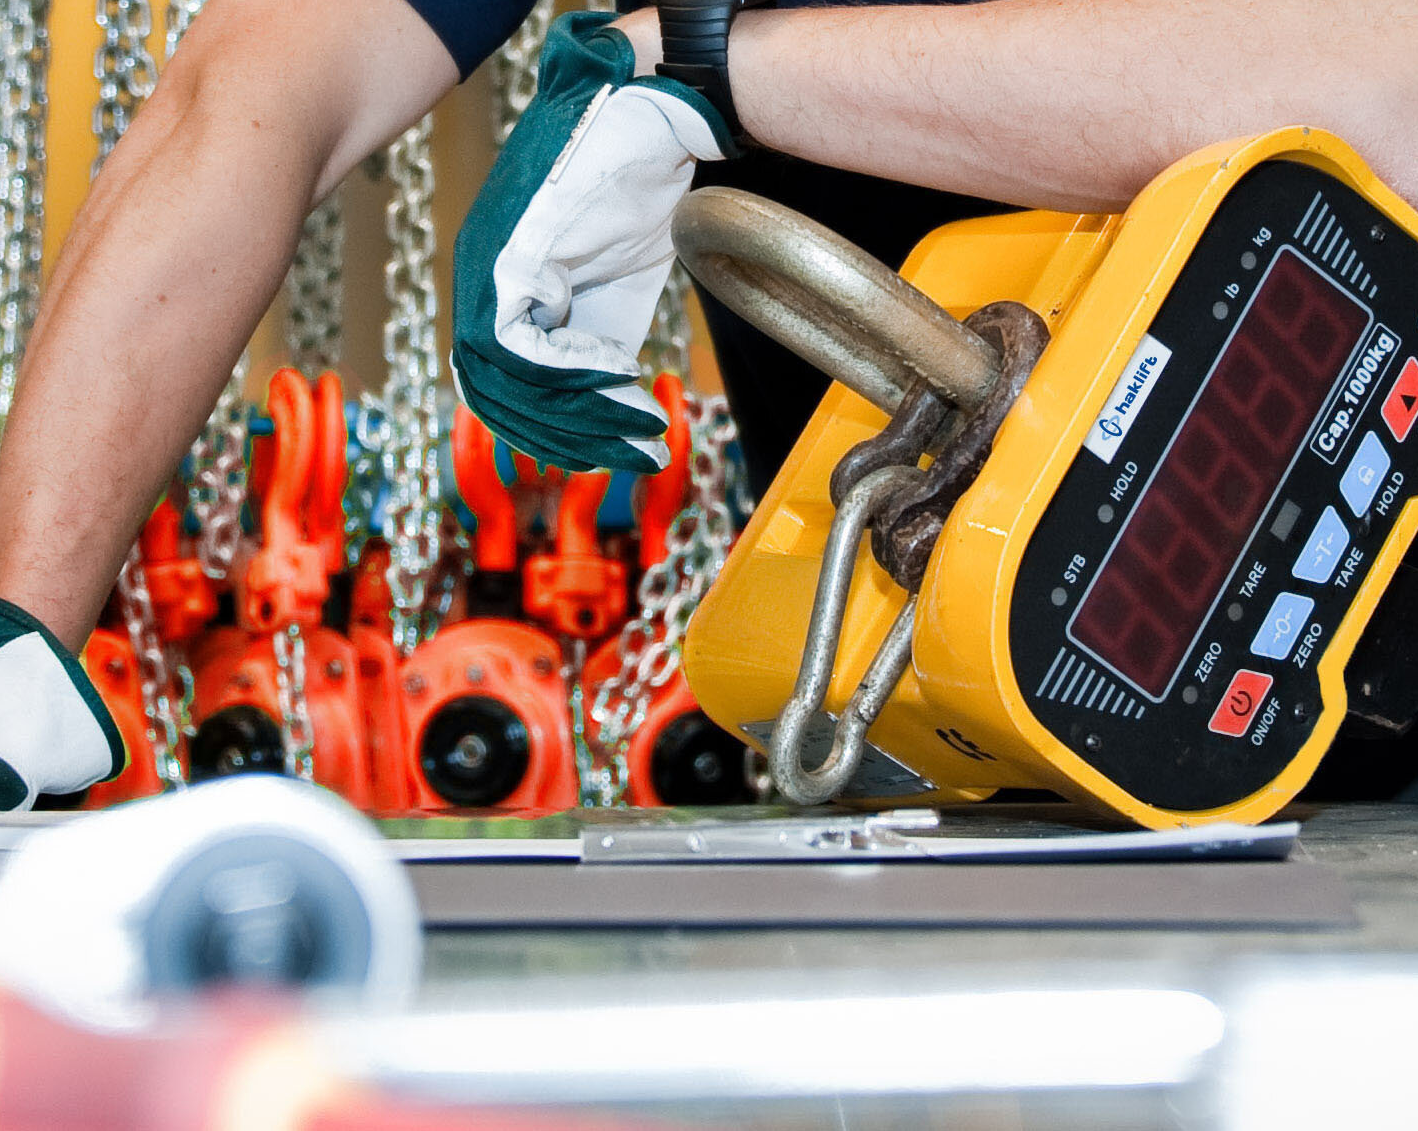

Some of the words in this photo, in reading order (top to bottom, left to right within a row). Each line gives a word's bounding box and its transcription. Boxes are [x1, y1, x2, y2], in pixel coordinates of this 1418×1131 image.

[1252, 227, 1272, 247] kg
[1224, 283, 1240, 299] lb
[1114, 356, 1158, 415] haklift
[1109, 461, 1138, 502] HOLD
[1375, 471, 1404, 516] HOLD
[1063, 554, 1086, 584] STB
[1238, 561, 1267, 599] TARE
[1334, 546, 1364, 588] TARE
[1194, 642, 1222, 684] ZERO
[1292, 622, 1322, 669] ZERO
[1251, 696, 1281, 746] ON/OFF
